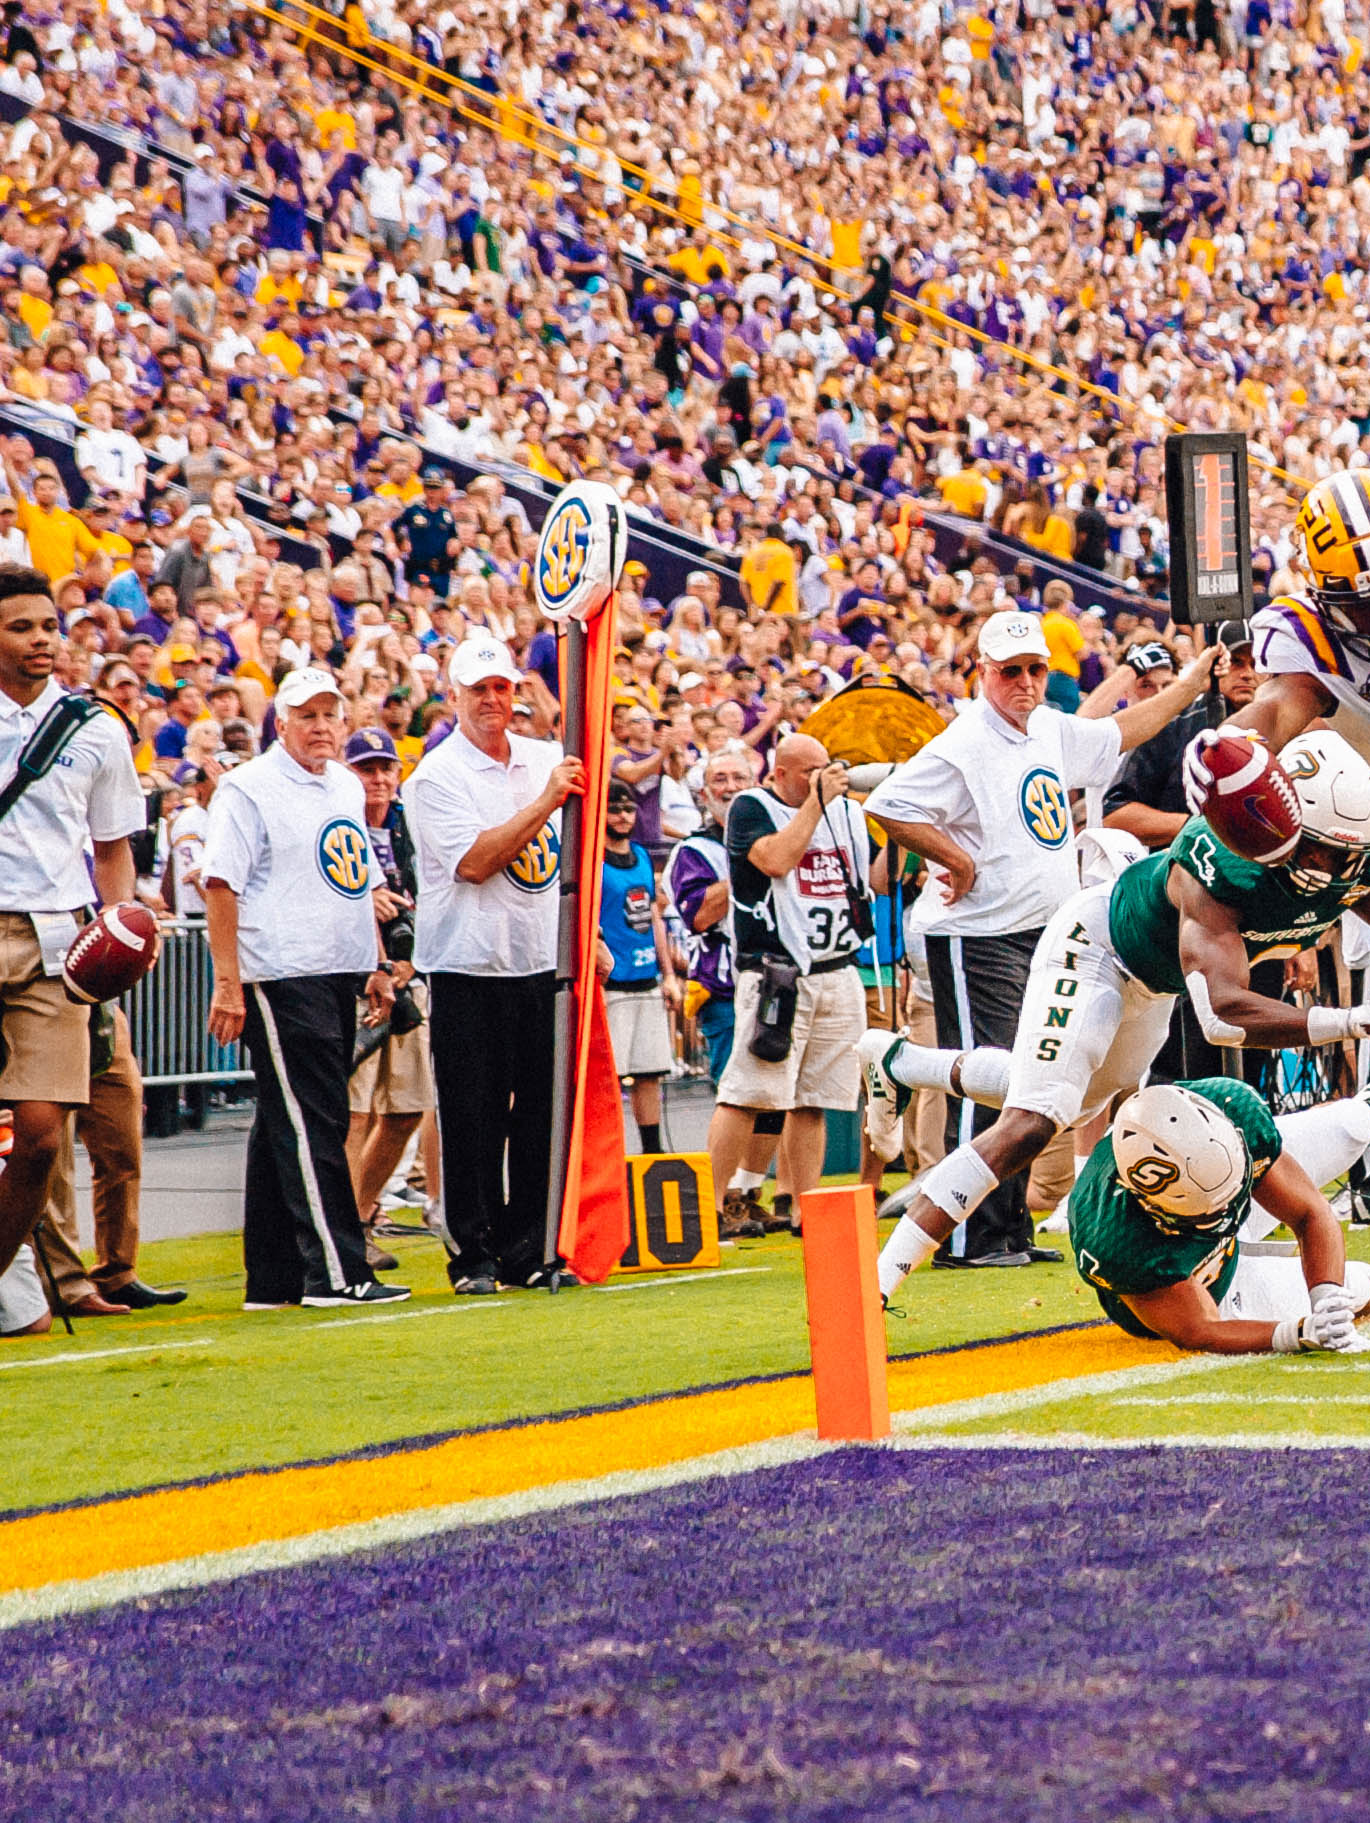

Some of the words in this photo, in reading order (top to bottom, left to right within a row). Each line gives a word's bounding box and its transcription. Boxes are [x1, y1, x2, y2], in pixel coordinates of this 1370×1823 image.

[542, 503, 591, 597] SEC
[1025, 773, 1068, 842] SEC
[322, 824, 369, 890] SEC
[806, 906, 852, 952] 32
[1036, 921, 1091, 1062] LIONS
